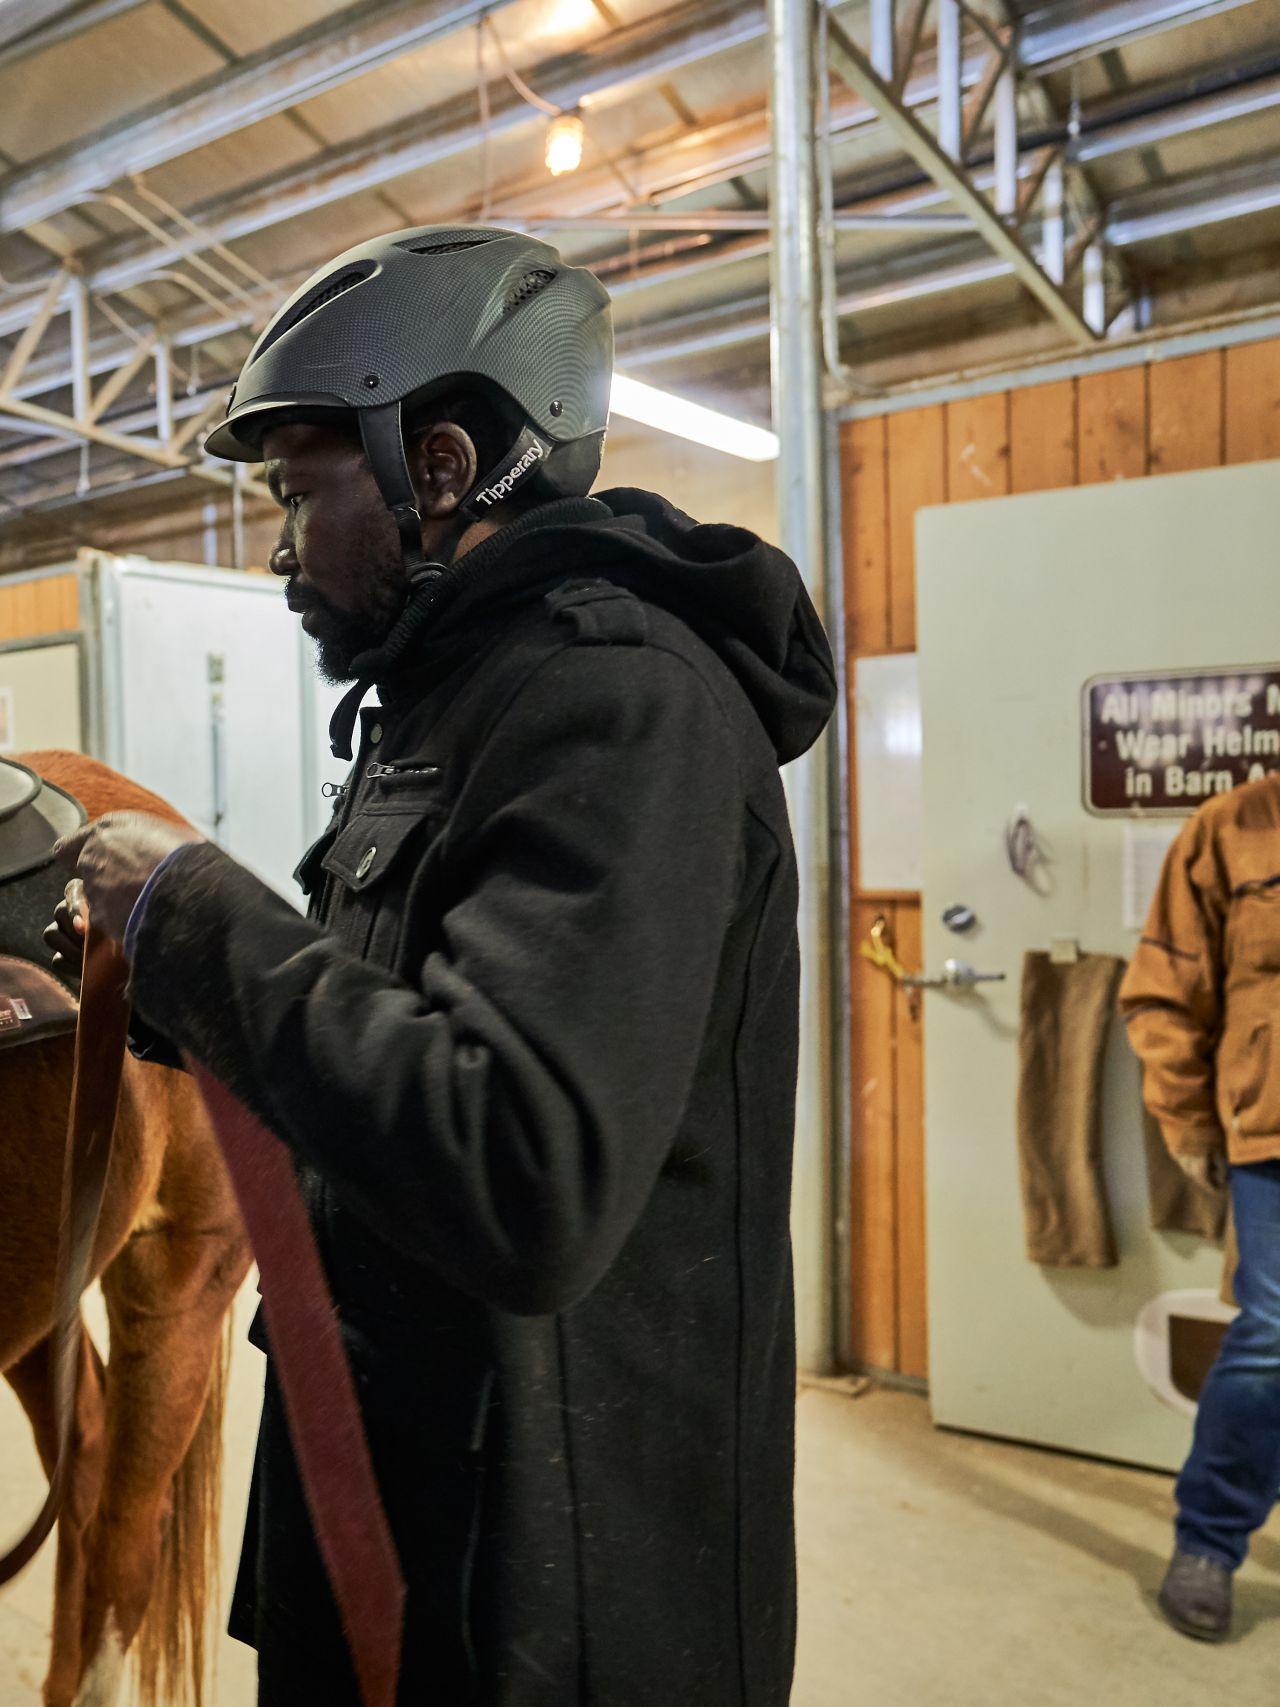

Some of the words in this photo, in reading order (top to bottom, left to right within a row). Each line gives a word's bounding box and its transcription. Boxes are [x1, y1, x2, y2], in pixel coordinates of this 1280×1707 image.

[475, 438, 544, 506] Tipperary
[1100, 692, 1138, 725] All
[1150, 688, 1253, 722] Minors
[1115, 729, 1191, 761] Wear
[1124, 766, 1153, 798] in
[1164, 765, 1234, 797] Barn
